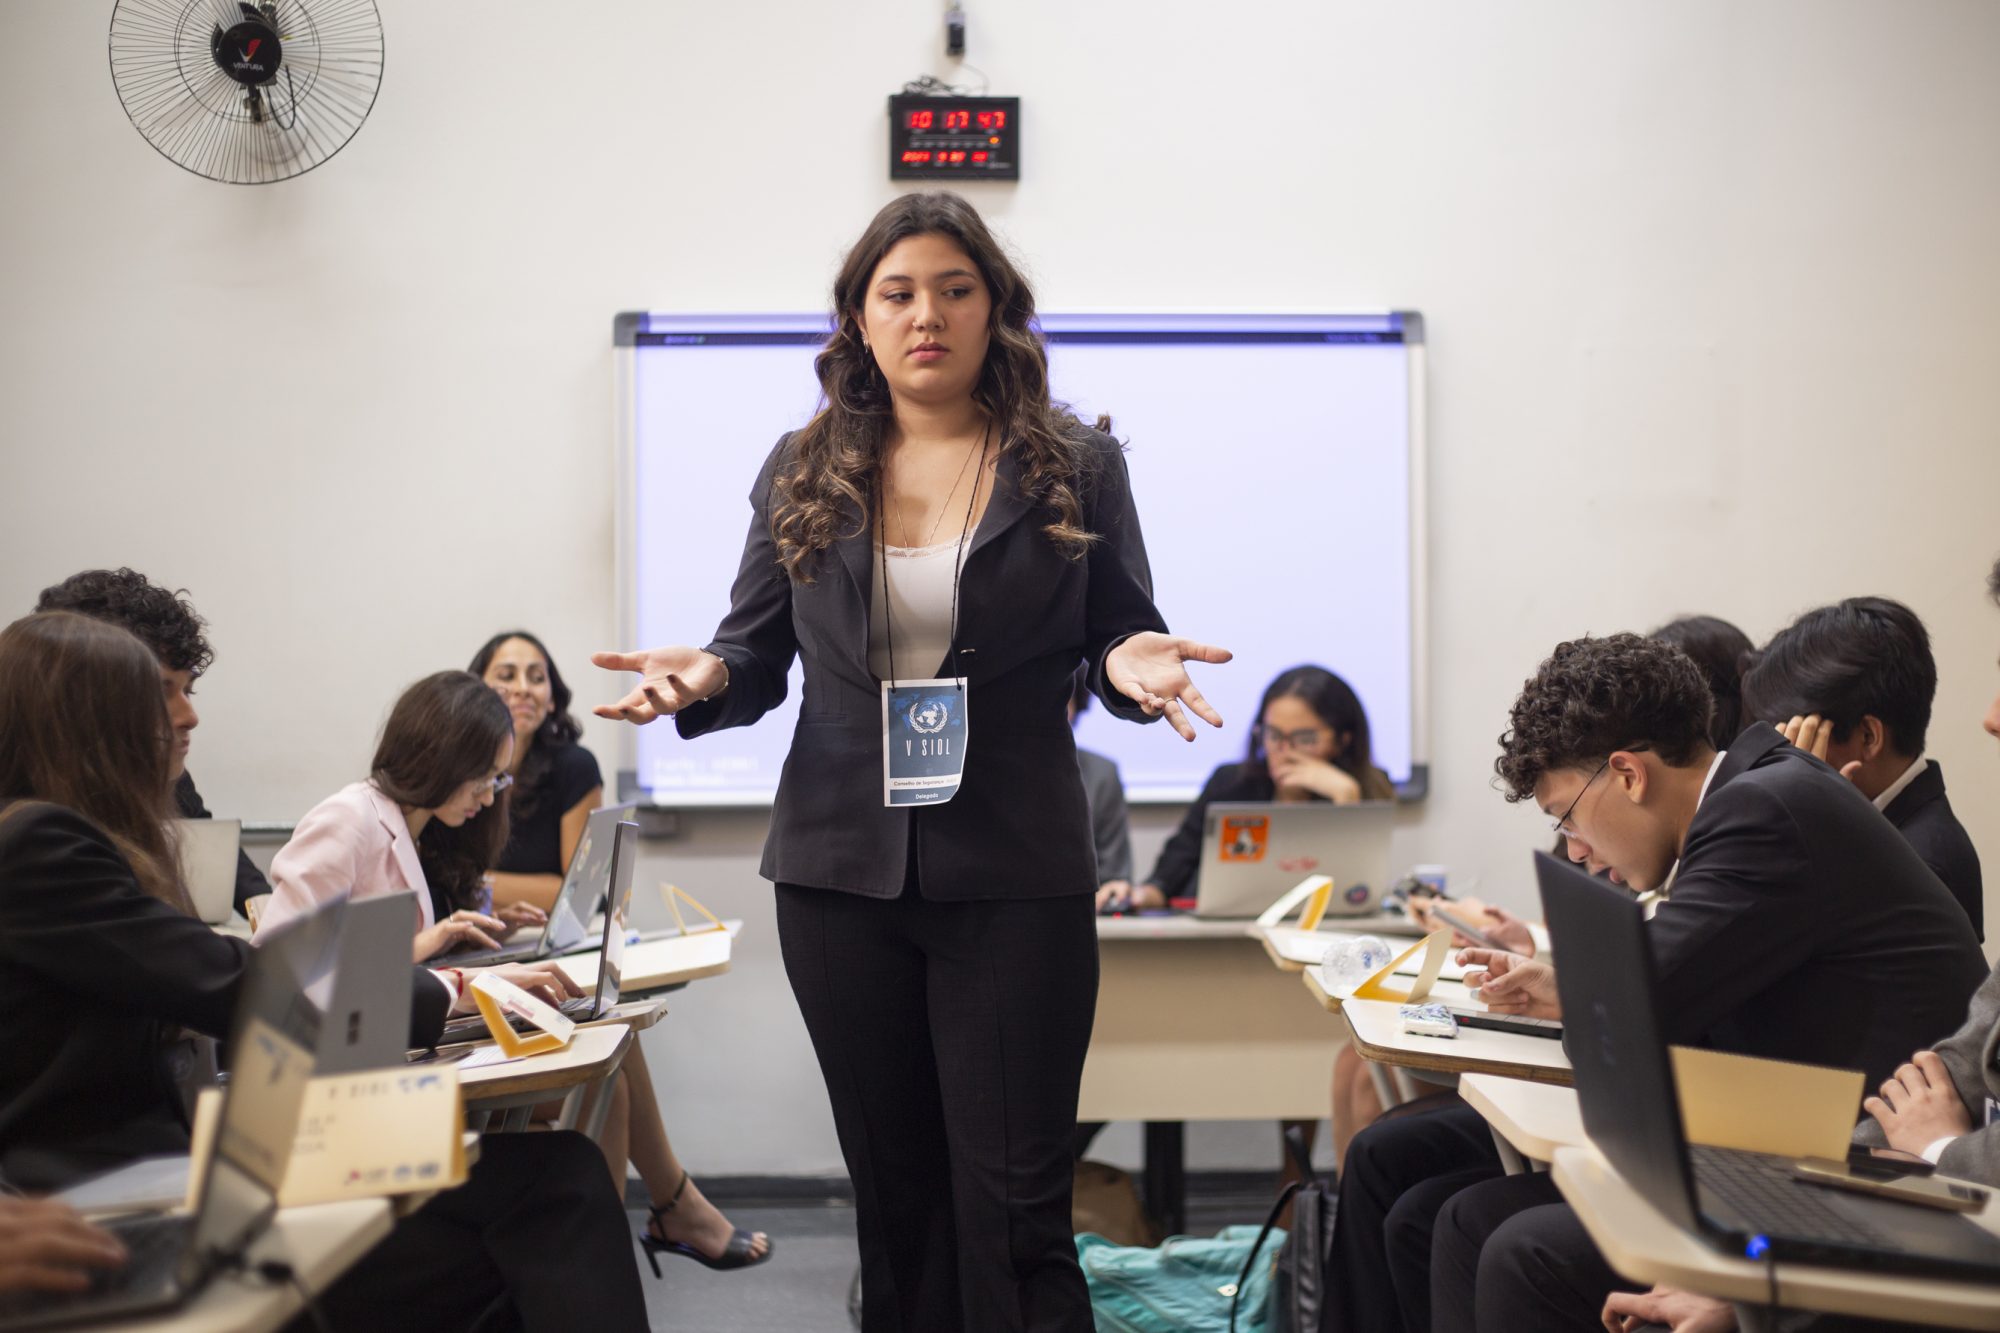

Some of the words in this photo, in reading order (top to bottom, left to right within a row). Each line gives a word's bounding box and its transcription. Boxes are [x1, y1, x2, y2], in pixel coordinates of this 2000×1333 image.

[910, 110, 934, 129] 10
[946, 110, 970, 129] 17
[977, 110, 1006, 129] 47
[906, 739, 912, 756] V
[922, 738, 950, 756] SIOL
